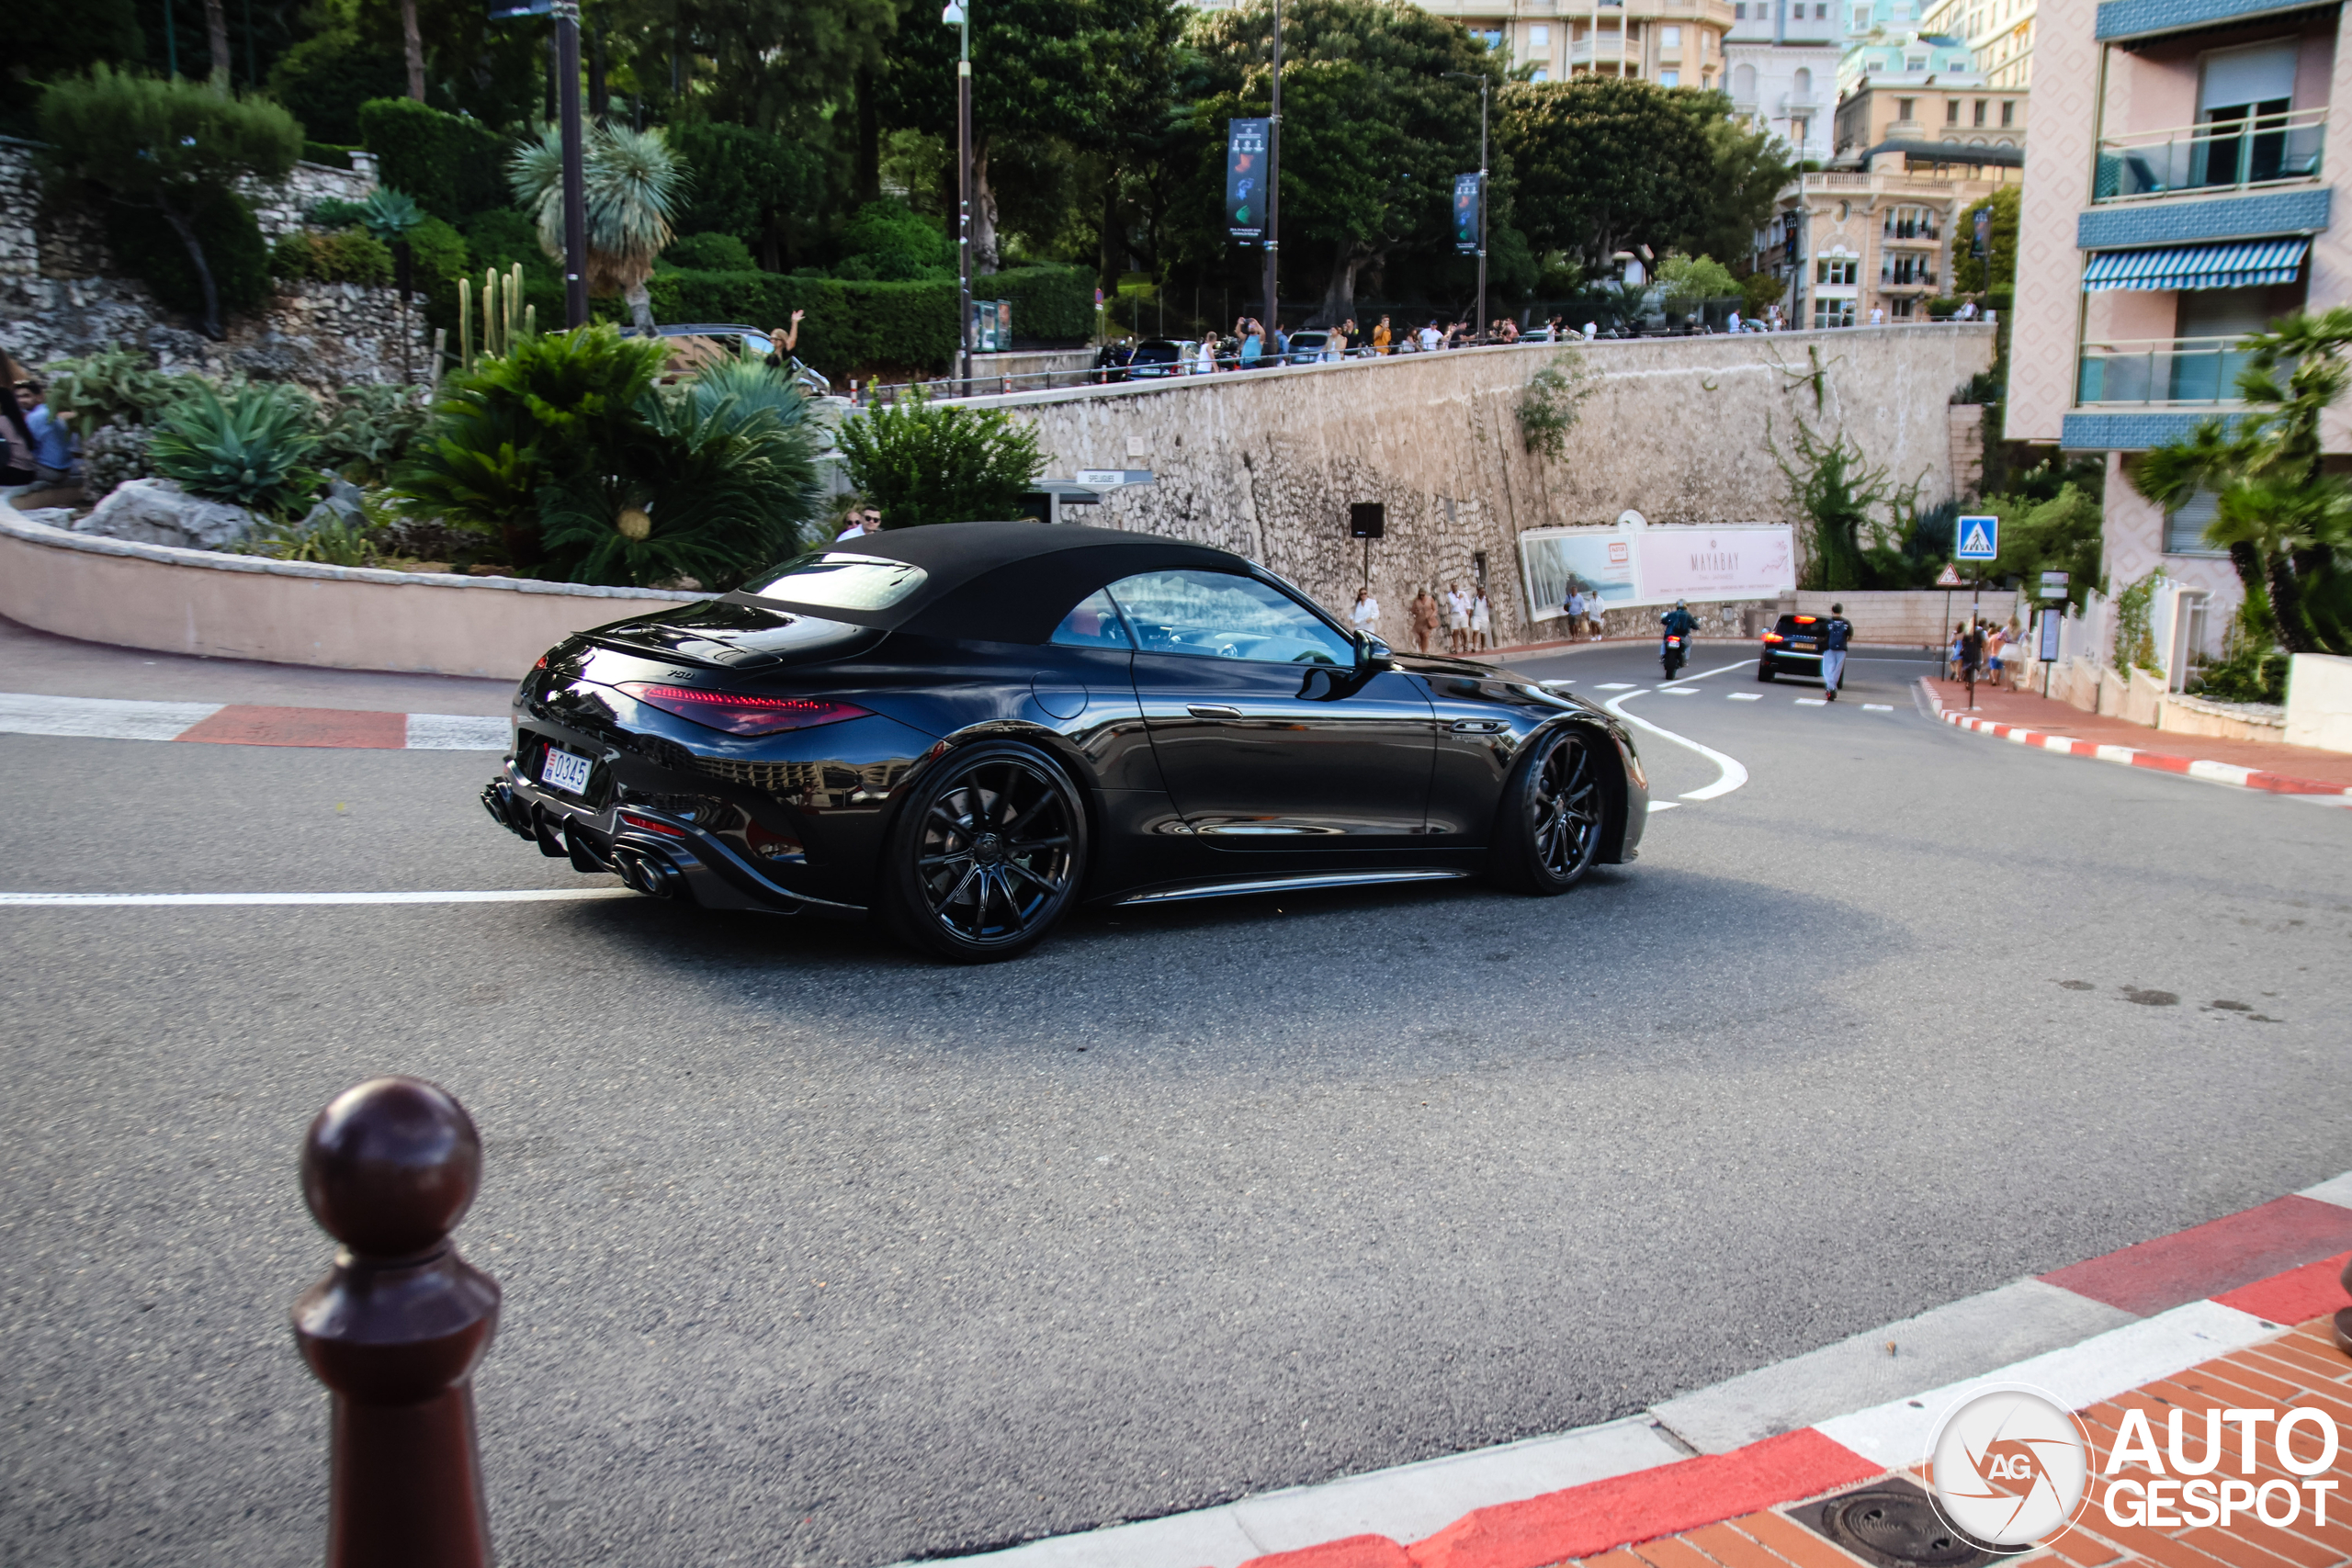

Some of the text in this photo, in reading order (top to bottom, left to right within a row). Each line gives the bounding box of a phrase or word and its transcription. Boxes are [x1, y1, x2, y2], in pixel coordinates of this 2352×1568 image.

[1691, 552, 1739, 571] MAYABAY
[667, 670, 695, 680] 750
[555, 754, 586, 785] 0345
